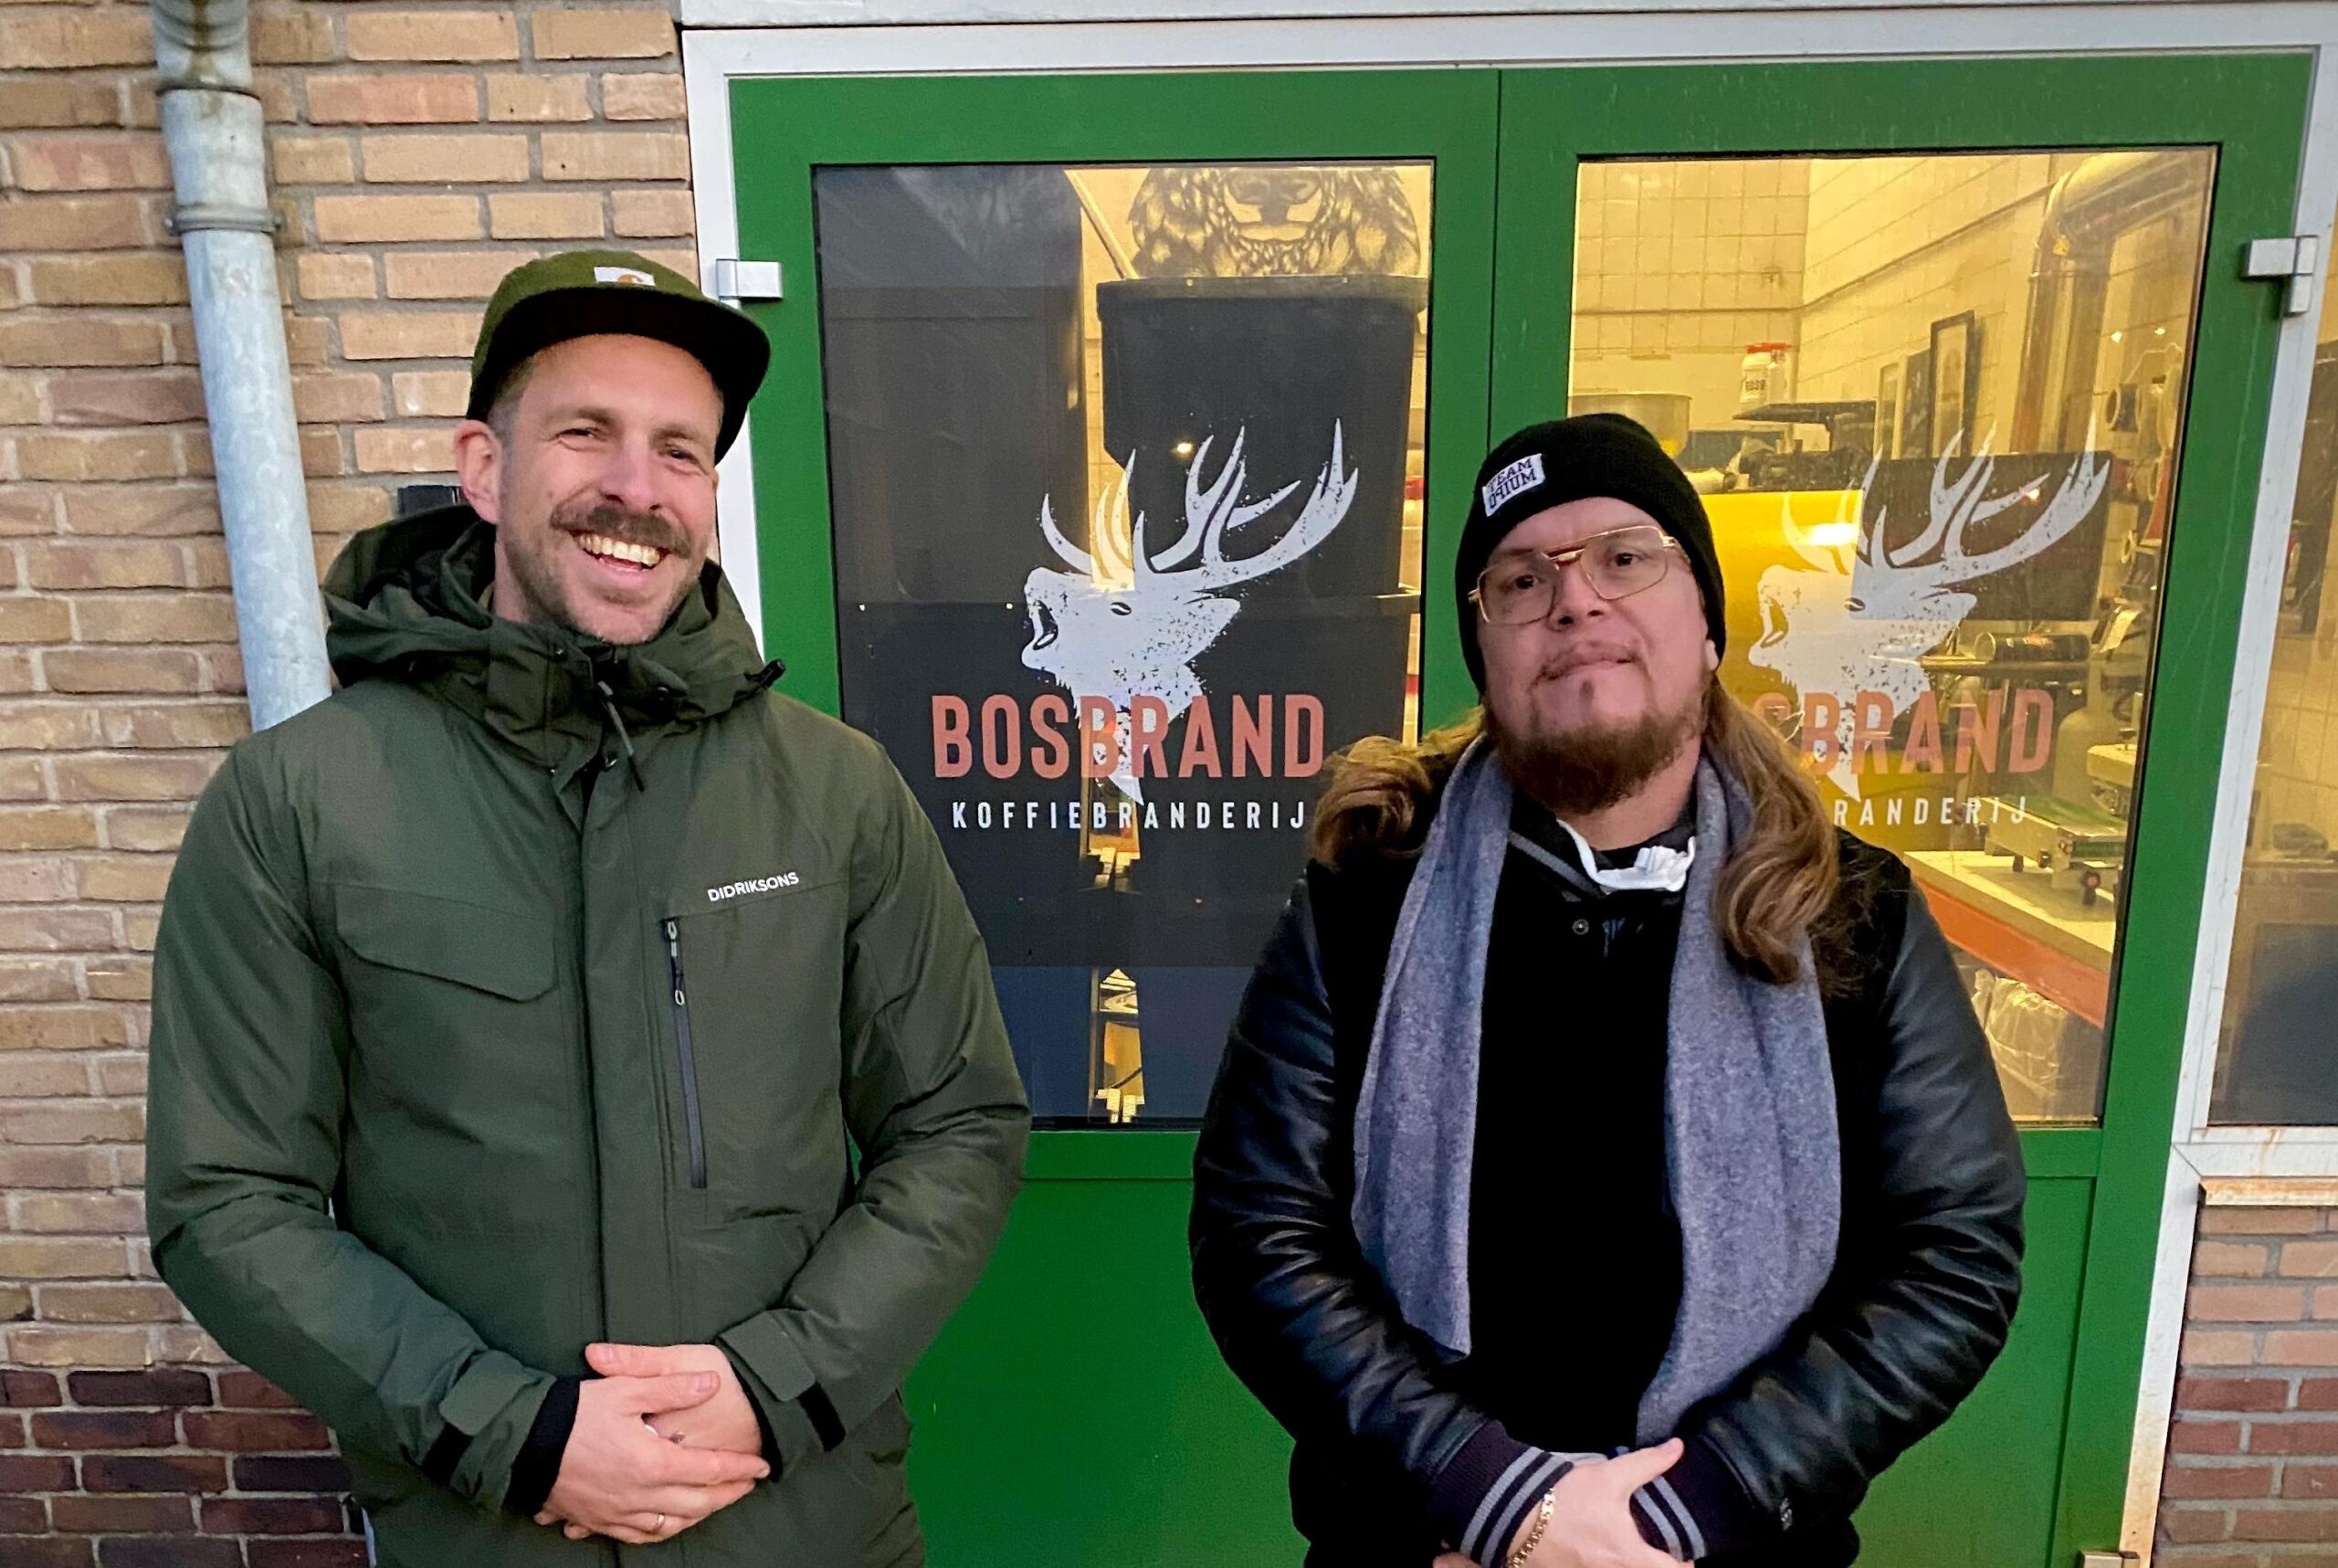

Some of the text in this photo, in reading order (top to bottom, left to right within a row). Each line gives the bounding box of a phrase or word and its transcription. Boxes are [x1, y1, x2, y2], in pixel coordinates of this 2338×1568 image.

[1487, 458, 1532, 492] TEAM
[932, 694, 1324, 779] BOSBRAND
[953, 801, 1304, 829] KOFFIEBRANDERIJ
[707, 871, 800, 902] DIDRIKSONS
